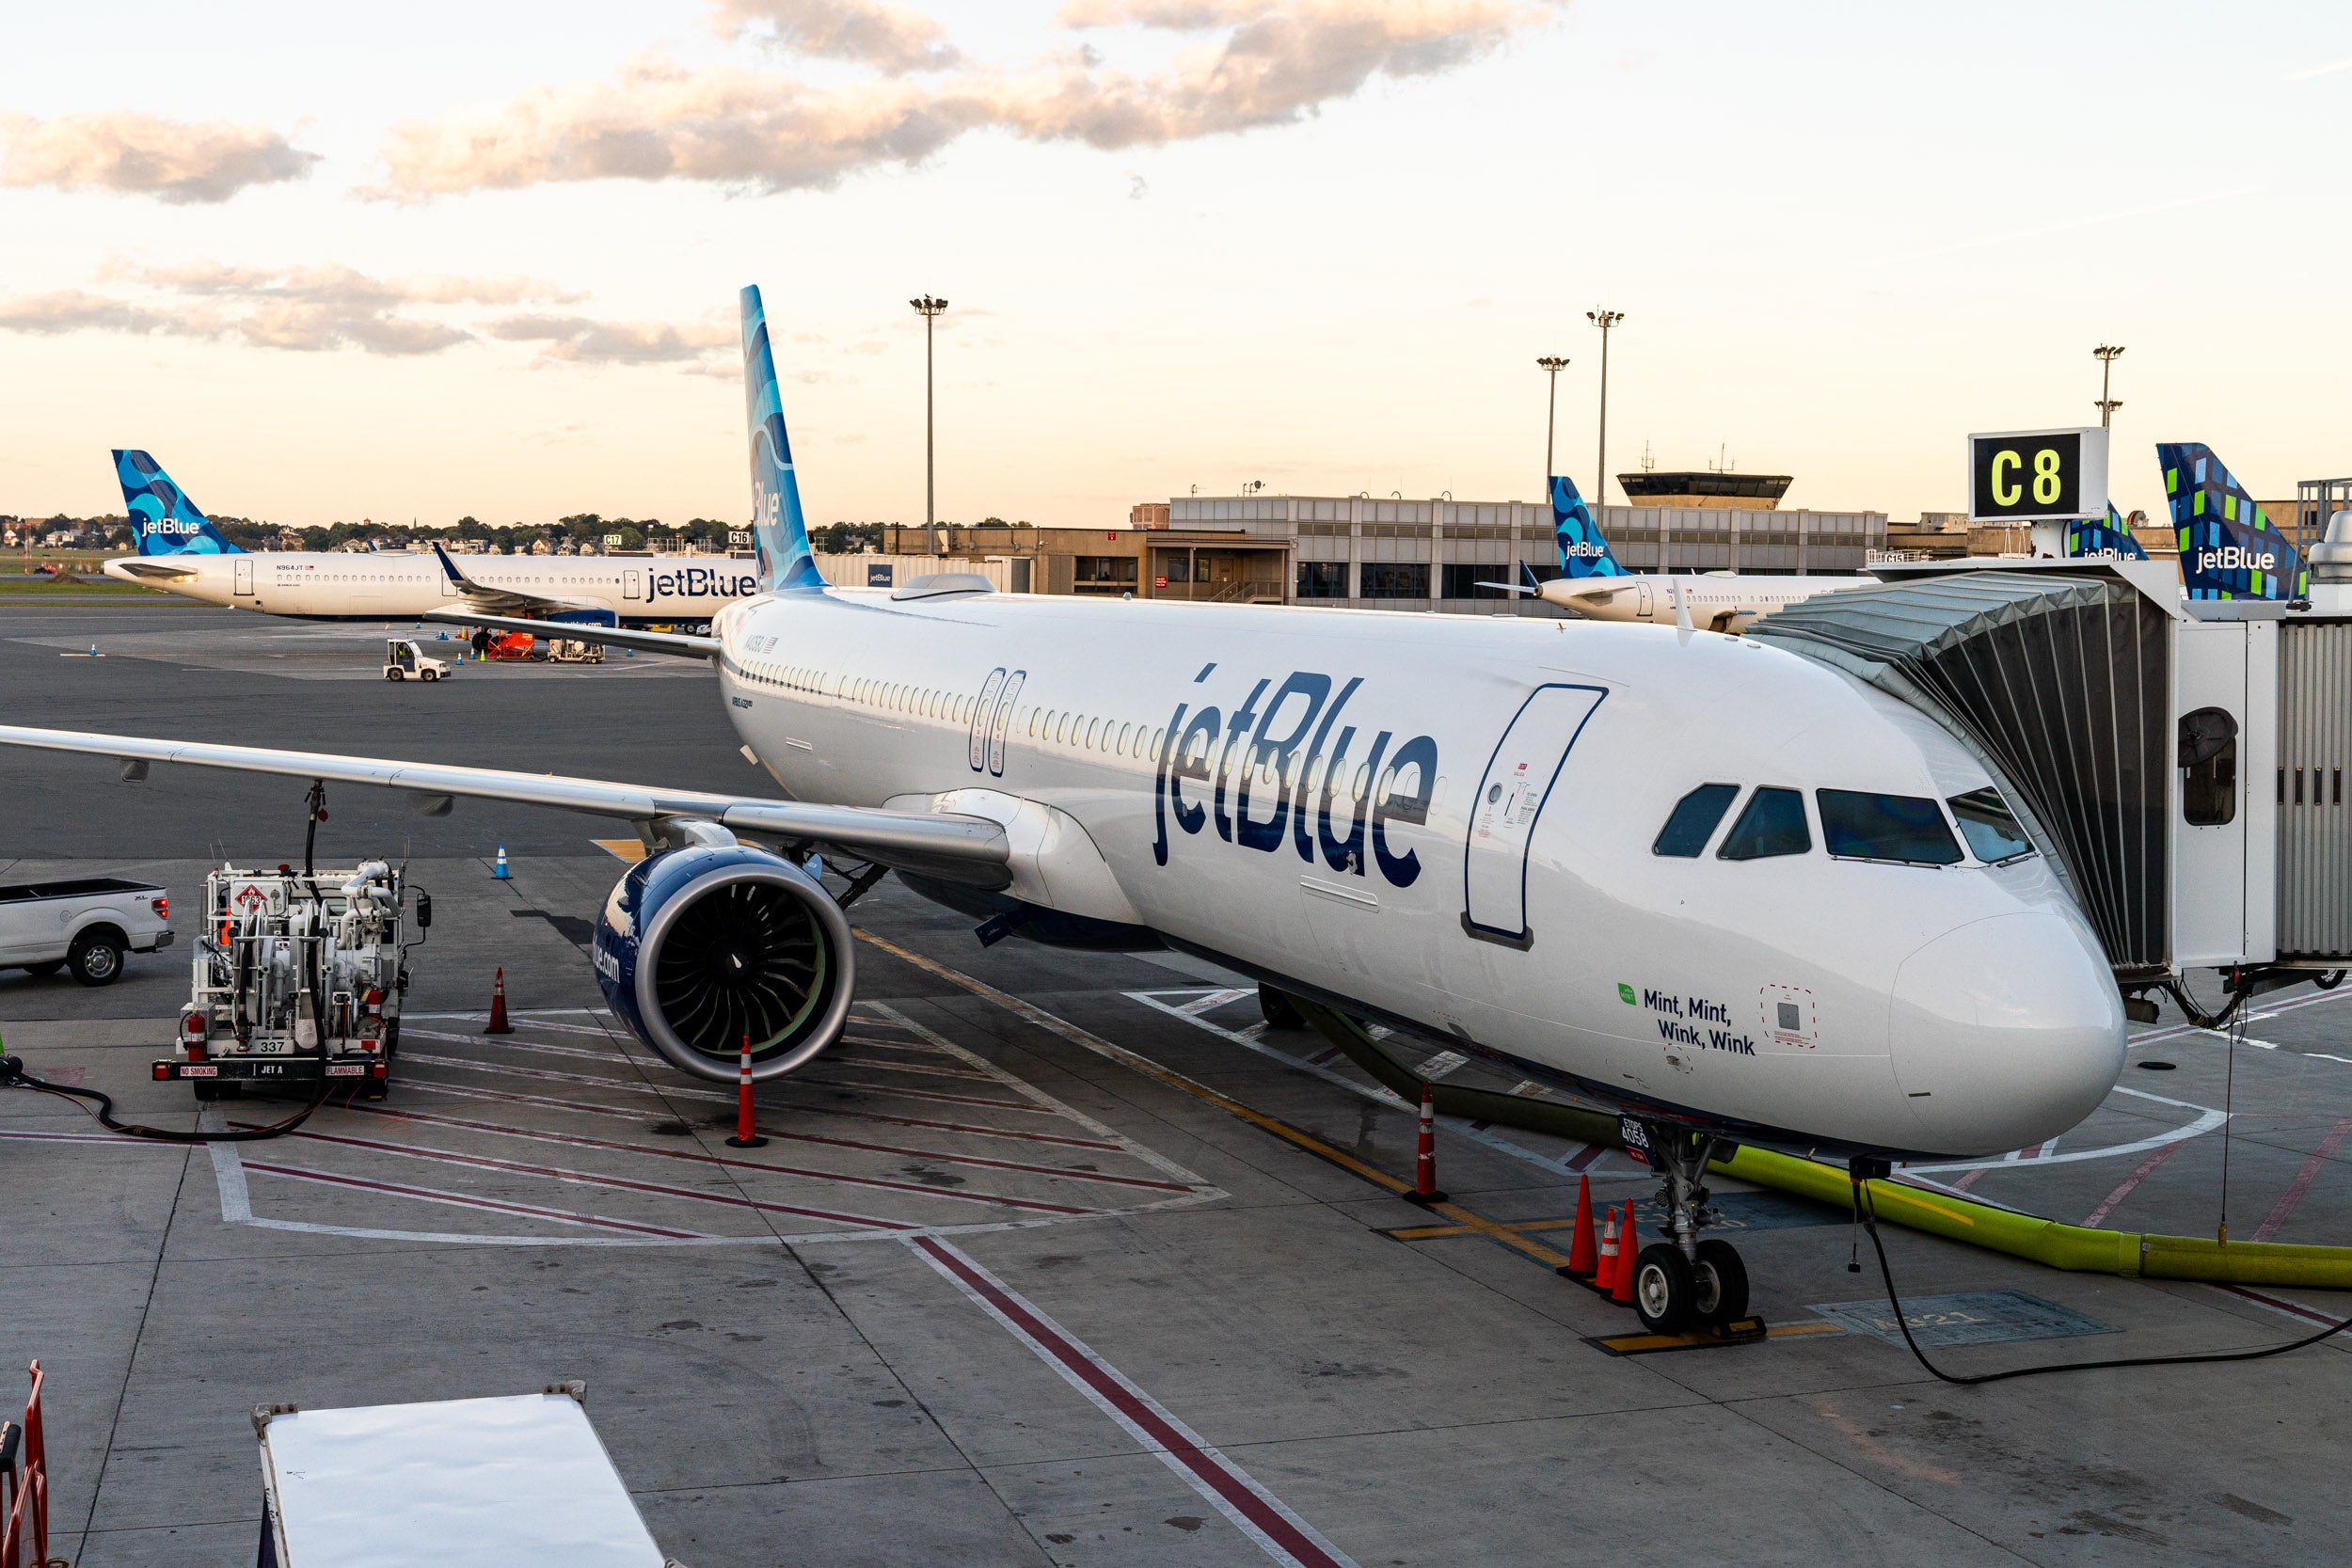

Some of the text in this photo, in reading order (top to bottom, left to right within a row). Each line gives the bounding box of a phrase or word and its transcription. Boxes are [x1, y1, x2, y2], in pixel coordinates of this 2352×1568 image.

[142, 517, 199, 537] jetBlue
[605, 535, 620, 545] C17
[731, 532, 748, 544] C16
[1565, 541, 1604, 561] jetBlue
[2195, 546, 2275, 575] jetBlue
[646, 567, 756, 603] jetBlue
[1152, 662, 1438, 888] jetBlue
[1644, 989, 1731, 1027] Mint, Mint,
[261, 1041, 285, 1052] 337
[1658, 1019, 1706, 1050] Wink,
[1708, 1029, 1756, 1056] Wink
[181, 1067, 216, 1076] NO SMOKING
[261, 1065, 275, 1074] JET
[326, 1065, 363, 1075] FLAMMABLE
[1622, 1126, 1649, 1148] 4058
